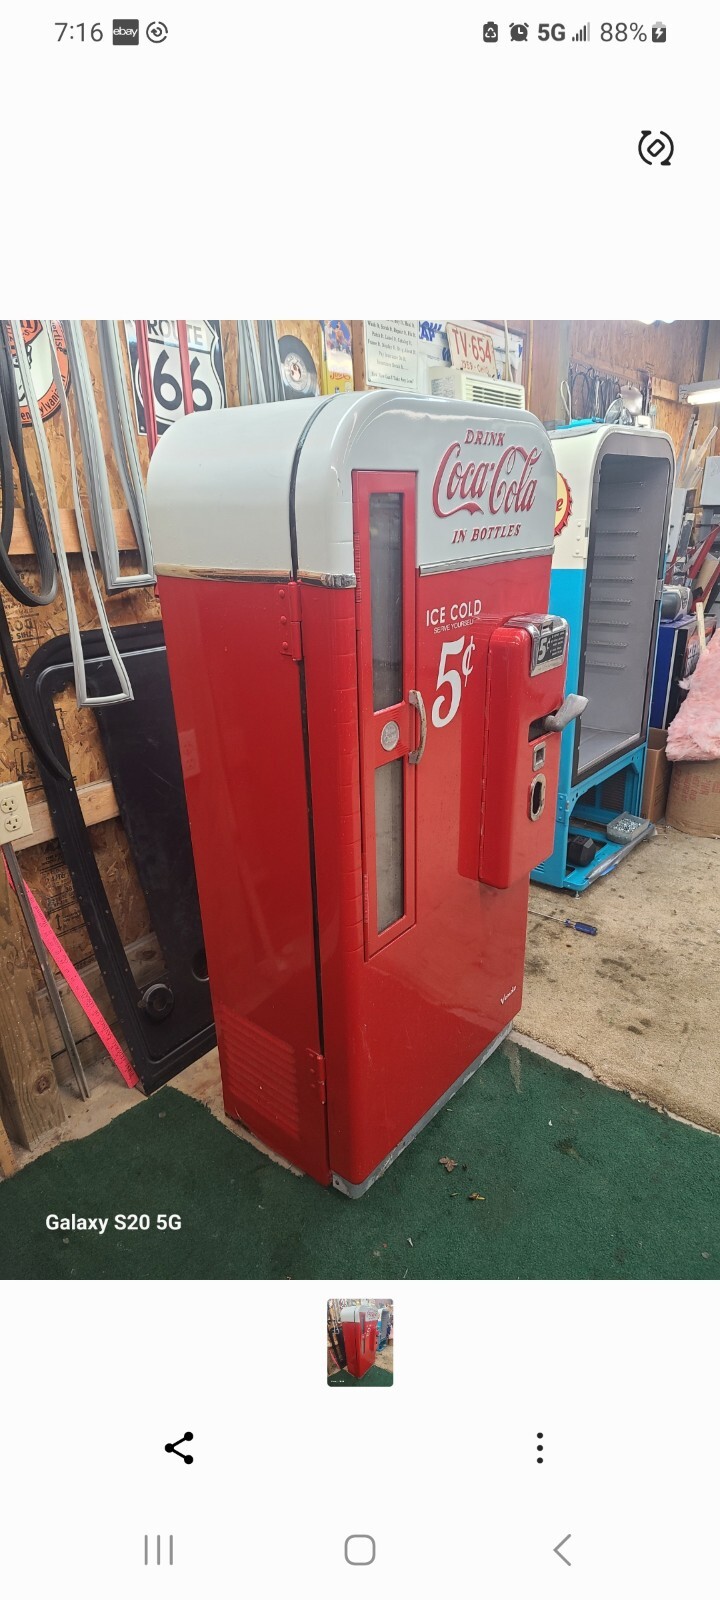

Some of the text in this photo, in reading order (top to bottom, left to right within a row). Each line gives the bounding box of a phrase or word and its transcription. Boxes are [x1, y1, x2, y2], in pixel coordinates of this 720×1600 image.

[54, 22, 138, 43] 7:16 ebay
[537, 21, 648, 43] 5G 88%
[153, 349, 213, 412] 66
[464, 428, 506, 447] DRINK
[450, 523, 522, 545] IN BOTTLES
[426, 599, 482, 627] ICE COLD
[431, 635, 476, 729] 5¢
